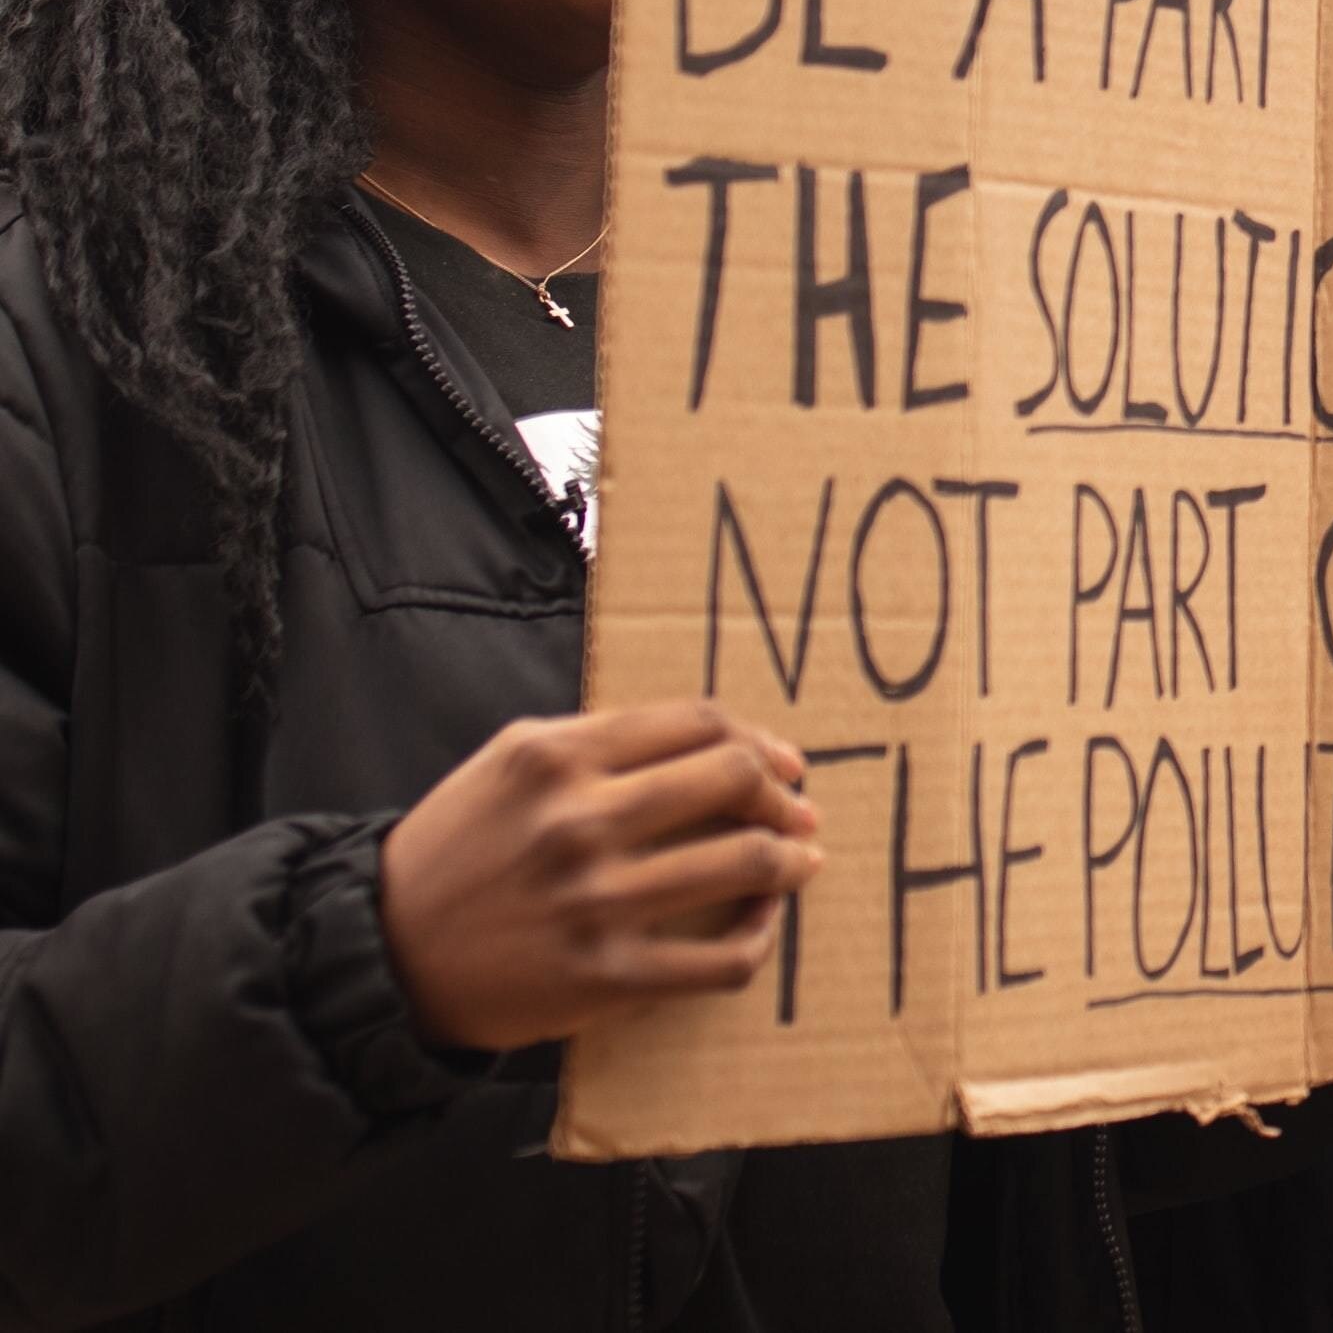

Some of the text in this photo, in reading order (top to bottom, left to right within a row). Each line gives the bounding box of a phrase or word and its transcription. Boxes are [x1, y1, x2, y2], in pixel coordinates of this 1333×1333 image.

[663, 155, 972, 414] THE
[703, 475, 1020, 702] NOT
[1069, 481, 1268, 710] PART
[776, 738, 1050, 1028] THE
